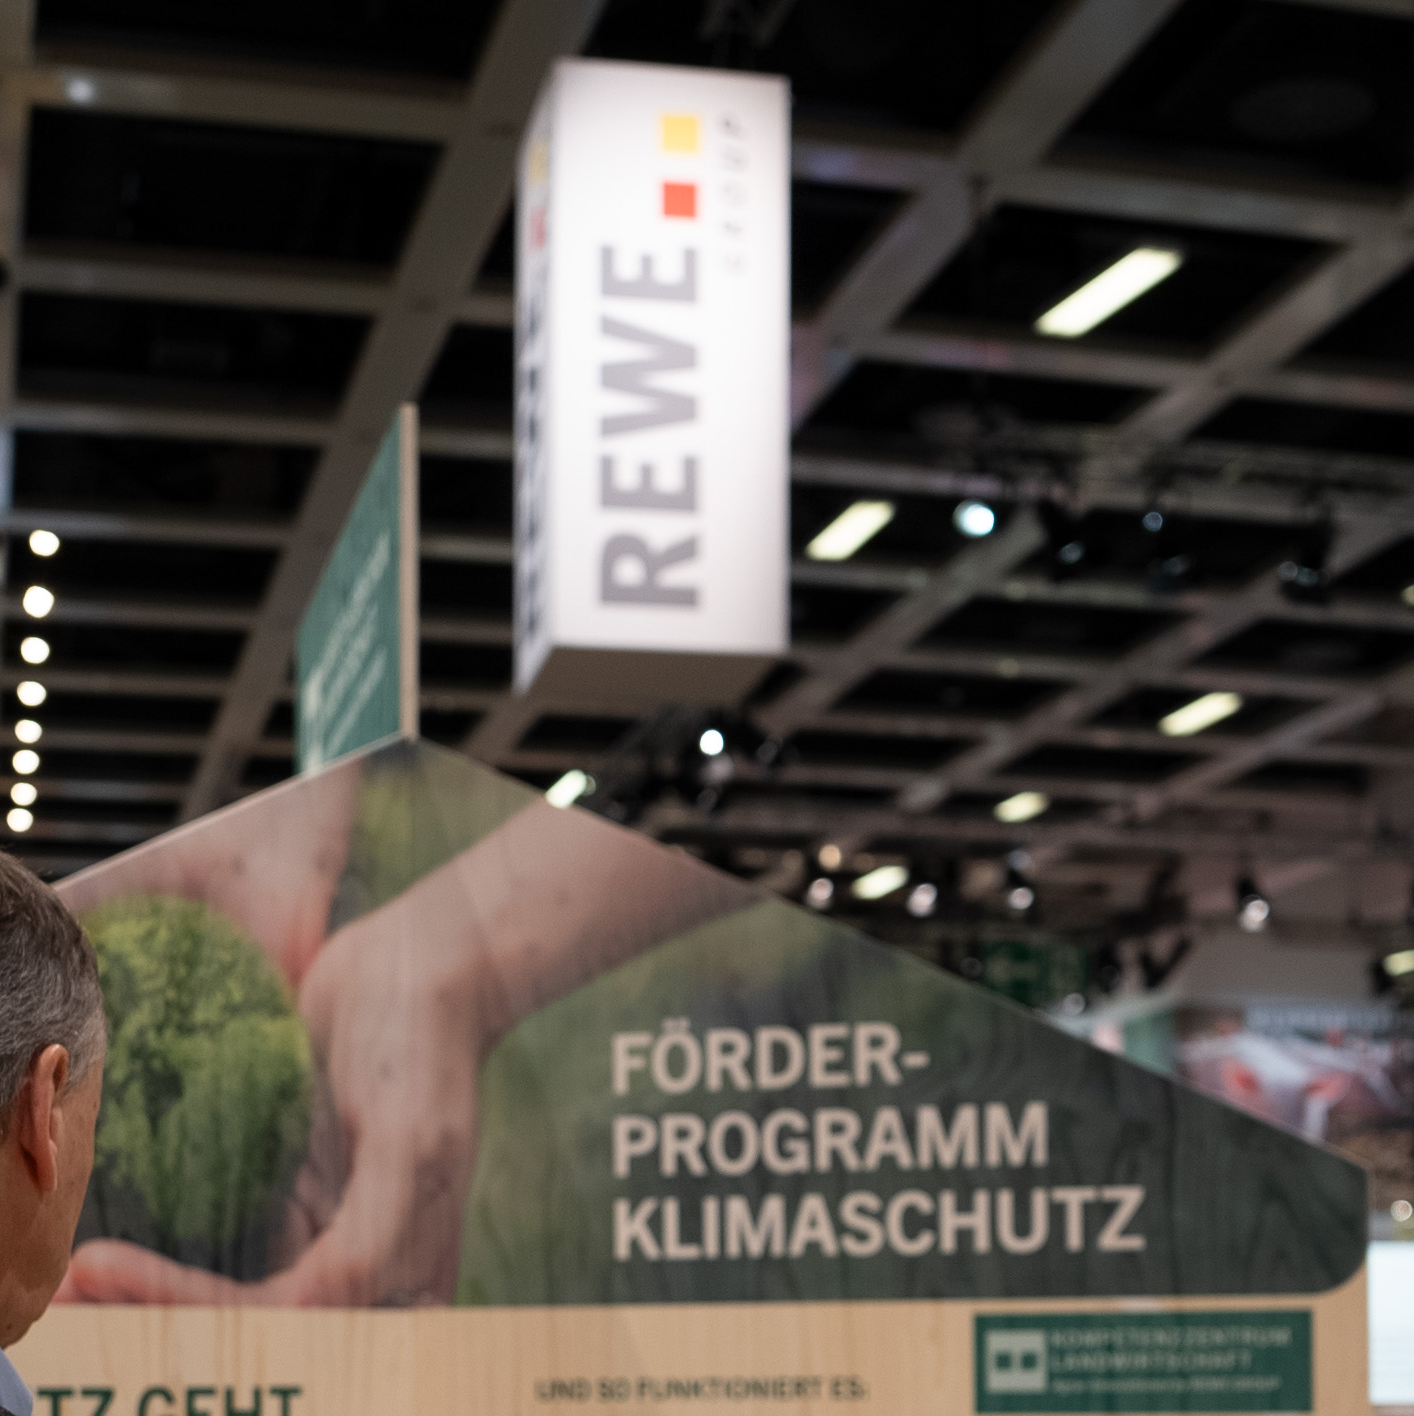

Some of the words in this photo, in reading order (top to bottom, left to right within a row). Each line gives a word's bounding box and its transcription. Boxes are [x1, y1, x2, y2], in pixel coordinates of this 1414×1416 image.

[599, 244, 699, 610] REWE
[611, 1017, 930, 1096] FÖRDER-
[612, 1101, 1050, 1178] PROGRAMM
[613, 1185, 1147, 1262] KLIMASCHUTZ
[536, 1377, 591, 1403] UND
[597, 1376, 631, 1402] SO
[636, 1375, 823, 1402] FUNKTIONIERT
[1050, 1349, 1253, 1373] LANDWIRTSCHAFT
